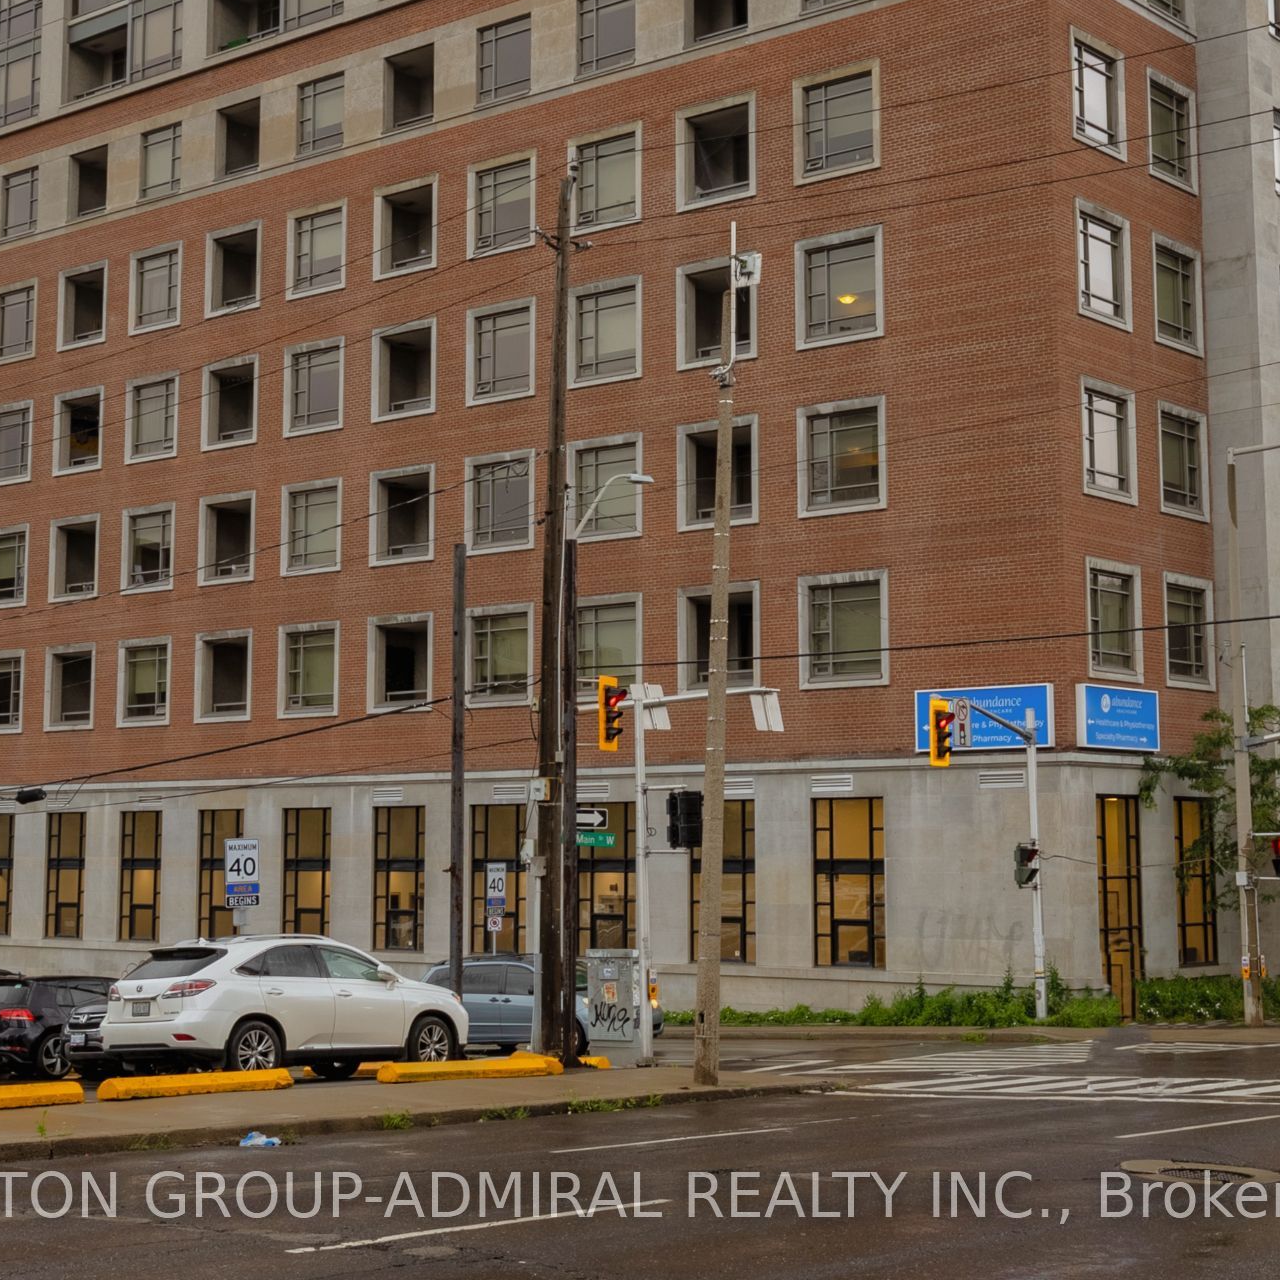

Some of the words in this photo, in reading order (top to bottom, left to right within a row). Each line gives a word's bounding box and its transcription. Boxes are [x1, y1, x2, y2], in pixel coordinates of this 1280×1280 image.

[973, 735, 1012, 744] Pharmacy
[576, 834, 595, 844] Main
[606, 835, 615, 845] W
[228, 857, 256, 876] 40
[489, 877, 504, 892] 40
[228, 896, 257, 906] BEGINS
